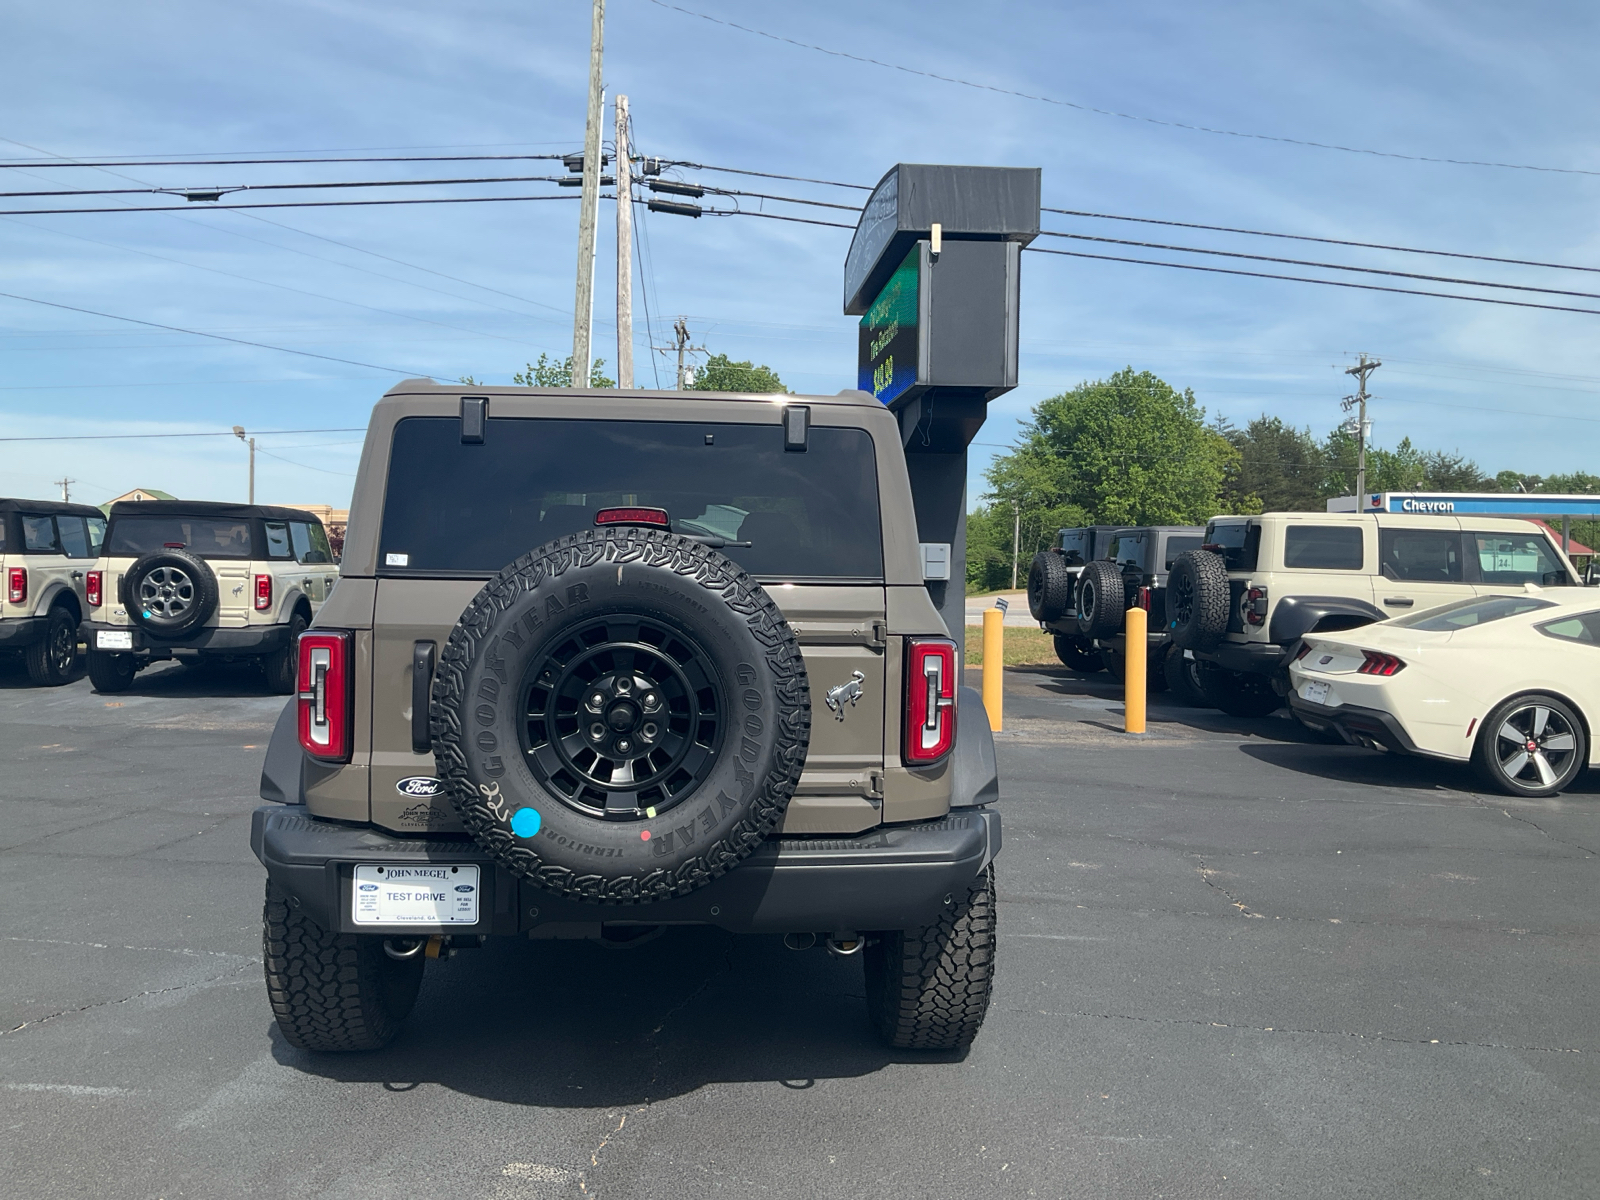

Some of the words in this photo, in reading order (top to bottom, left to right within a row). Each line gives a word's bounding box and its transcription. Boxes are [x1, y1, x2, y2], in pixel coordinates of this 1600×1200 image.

[1403, 499, 1455, 512] Chevron
[474, 582, 591, 778] GOODYEAR
[652, 662, 765, 858] GOODYEAR
[405, 780, 438, 793] Ford
[540, 825, 624, 858] TERRITORY
[385, 869, 412, 880] JOHN
[413, 869, 449, 880] MEGEL
[386, 892, 413, 901] TEST
[415, 892, 446, 901] DRIVE
